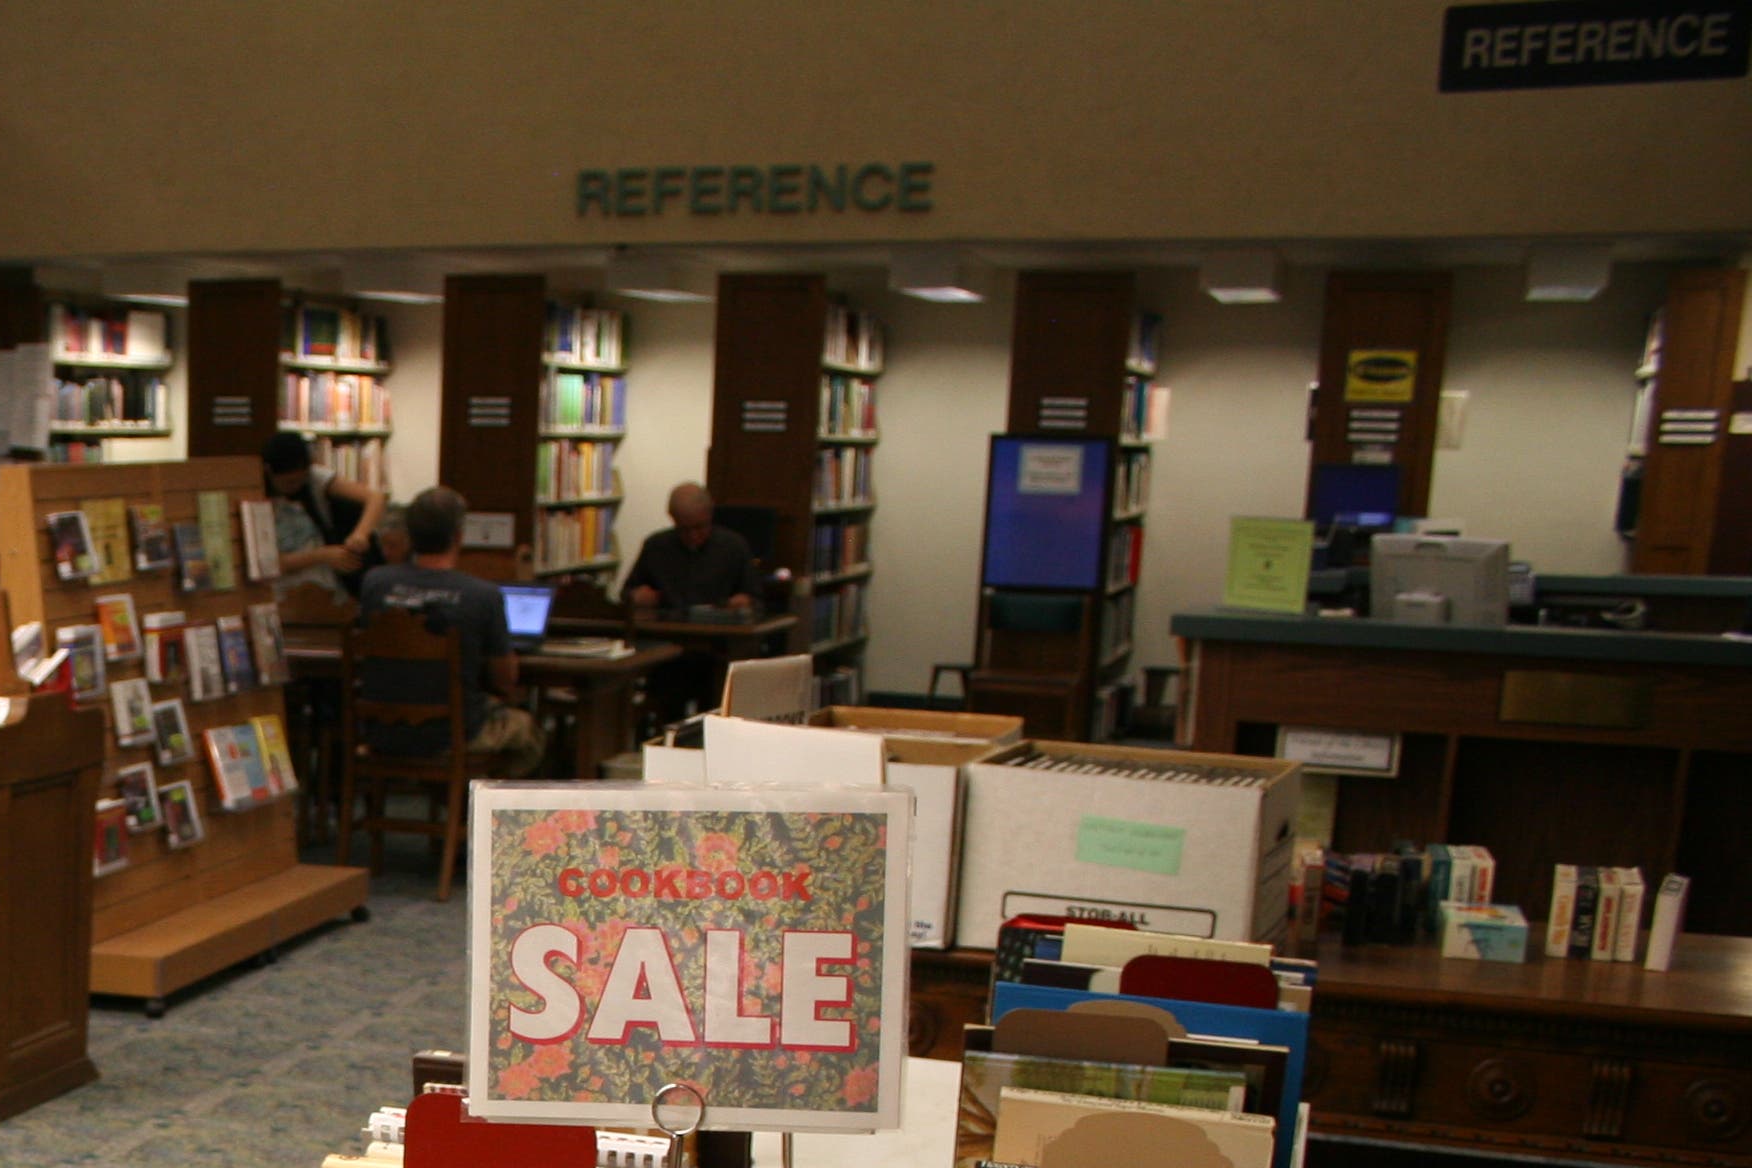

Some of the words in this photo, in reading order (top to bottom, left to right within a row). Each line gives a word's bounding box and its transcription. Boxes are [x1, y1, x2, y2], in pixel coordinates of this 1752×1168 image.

[1462, 13, 1732, 69] REFERENCE
[577, 162, 935, 218] REFERENCE
[557, 867, 814, 901] COOKBOOK
[508, 923, 858, 1053] SALE
